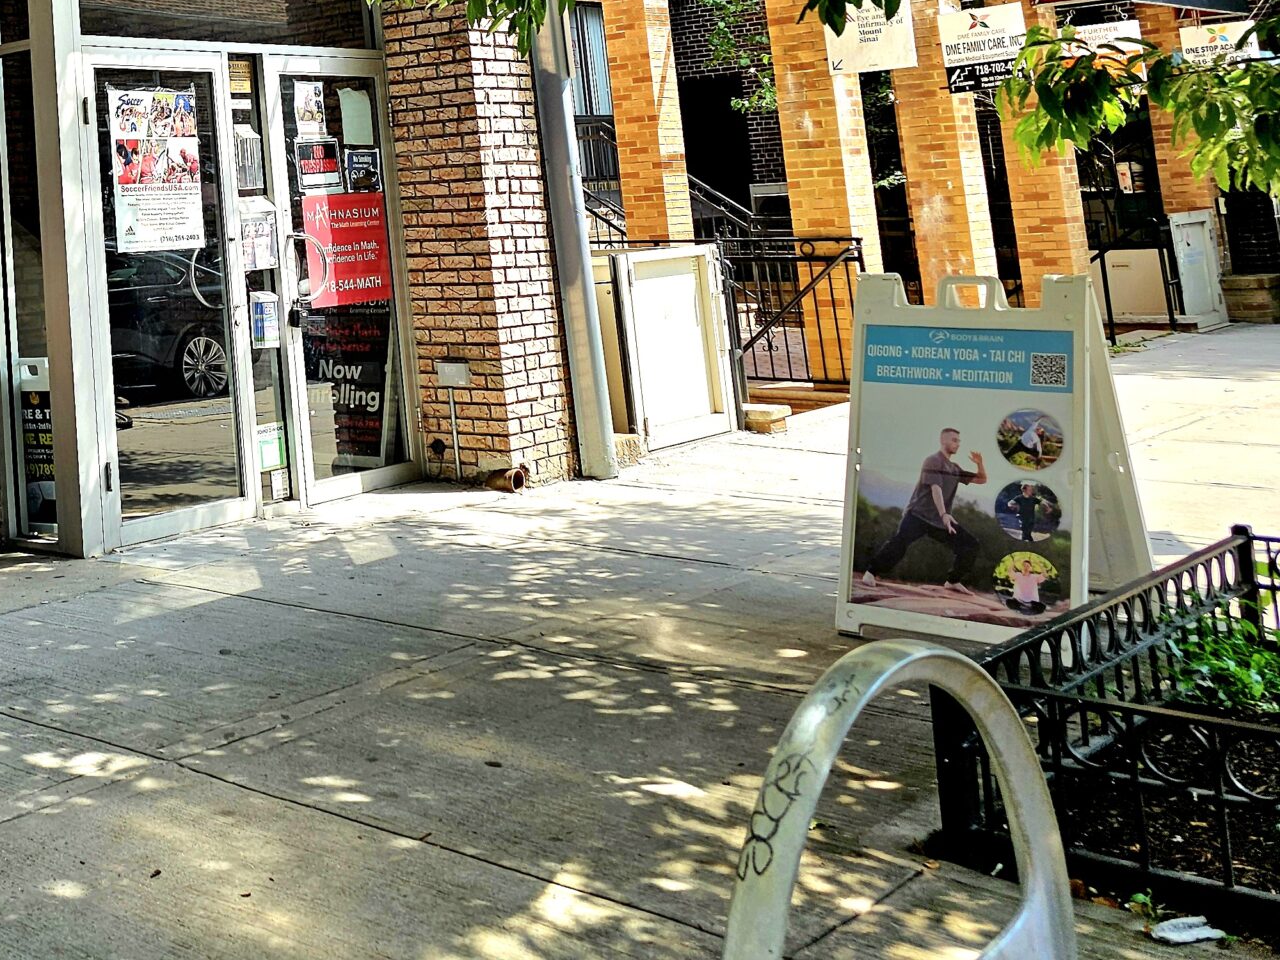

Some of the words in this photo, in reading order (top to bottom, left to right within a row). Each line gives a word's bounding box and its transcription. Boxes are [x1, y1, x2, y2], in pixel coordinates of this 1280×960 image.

[858, 28, 882, 36] Mount
[991, 27, 1007, 35] CARE
[1083, 26, 1119, 35] FURTHER
[859, 35, 879, 44] Sinai
[1084, 33, 1109, 42] MUSIC
[945, 43, 962, 56] DME
[963, 39, 986, 53] FAMILY
[1185, 47, 1200, 55] ONE
[1200, 44, 1219, 53] STOP
[312, 145, 325, 159] NO
[120, 184, 199, 193] SoccerFriendsUSA.com
[307, 202, 380, 230] MATHNASIUM
[353, 241, 360, 250] In
[356, 252, 363, 261] In
[326, 276, 382, 292] 18-544-MATH
[867, 344, 902, 357] QIGONG
[911, 346, 950, 359] KOREAN
[953, 347, 979, 361] YOGA
[989, 349, 1005, 362] TAI
[1008, 350, 1025, 363] CHI
[319, 359, 362, 380] Now
[877, 365, 943, 380] BREATHWORK
[952, 369, 1013, 384] MEDITATION
